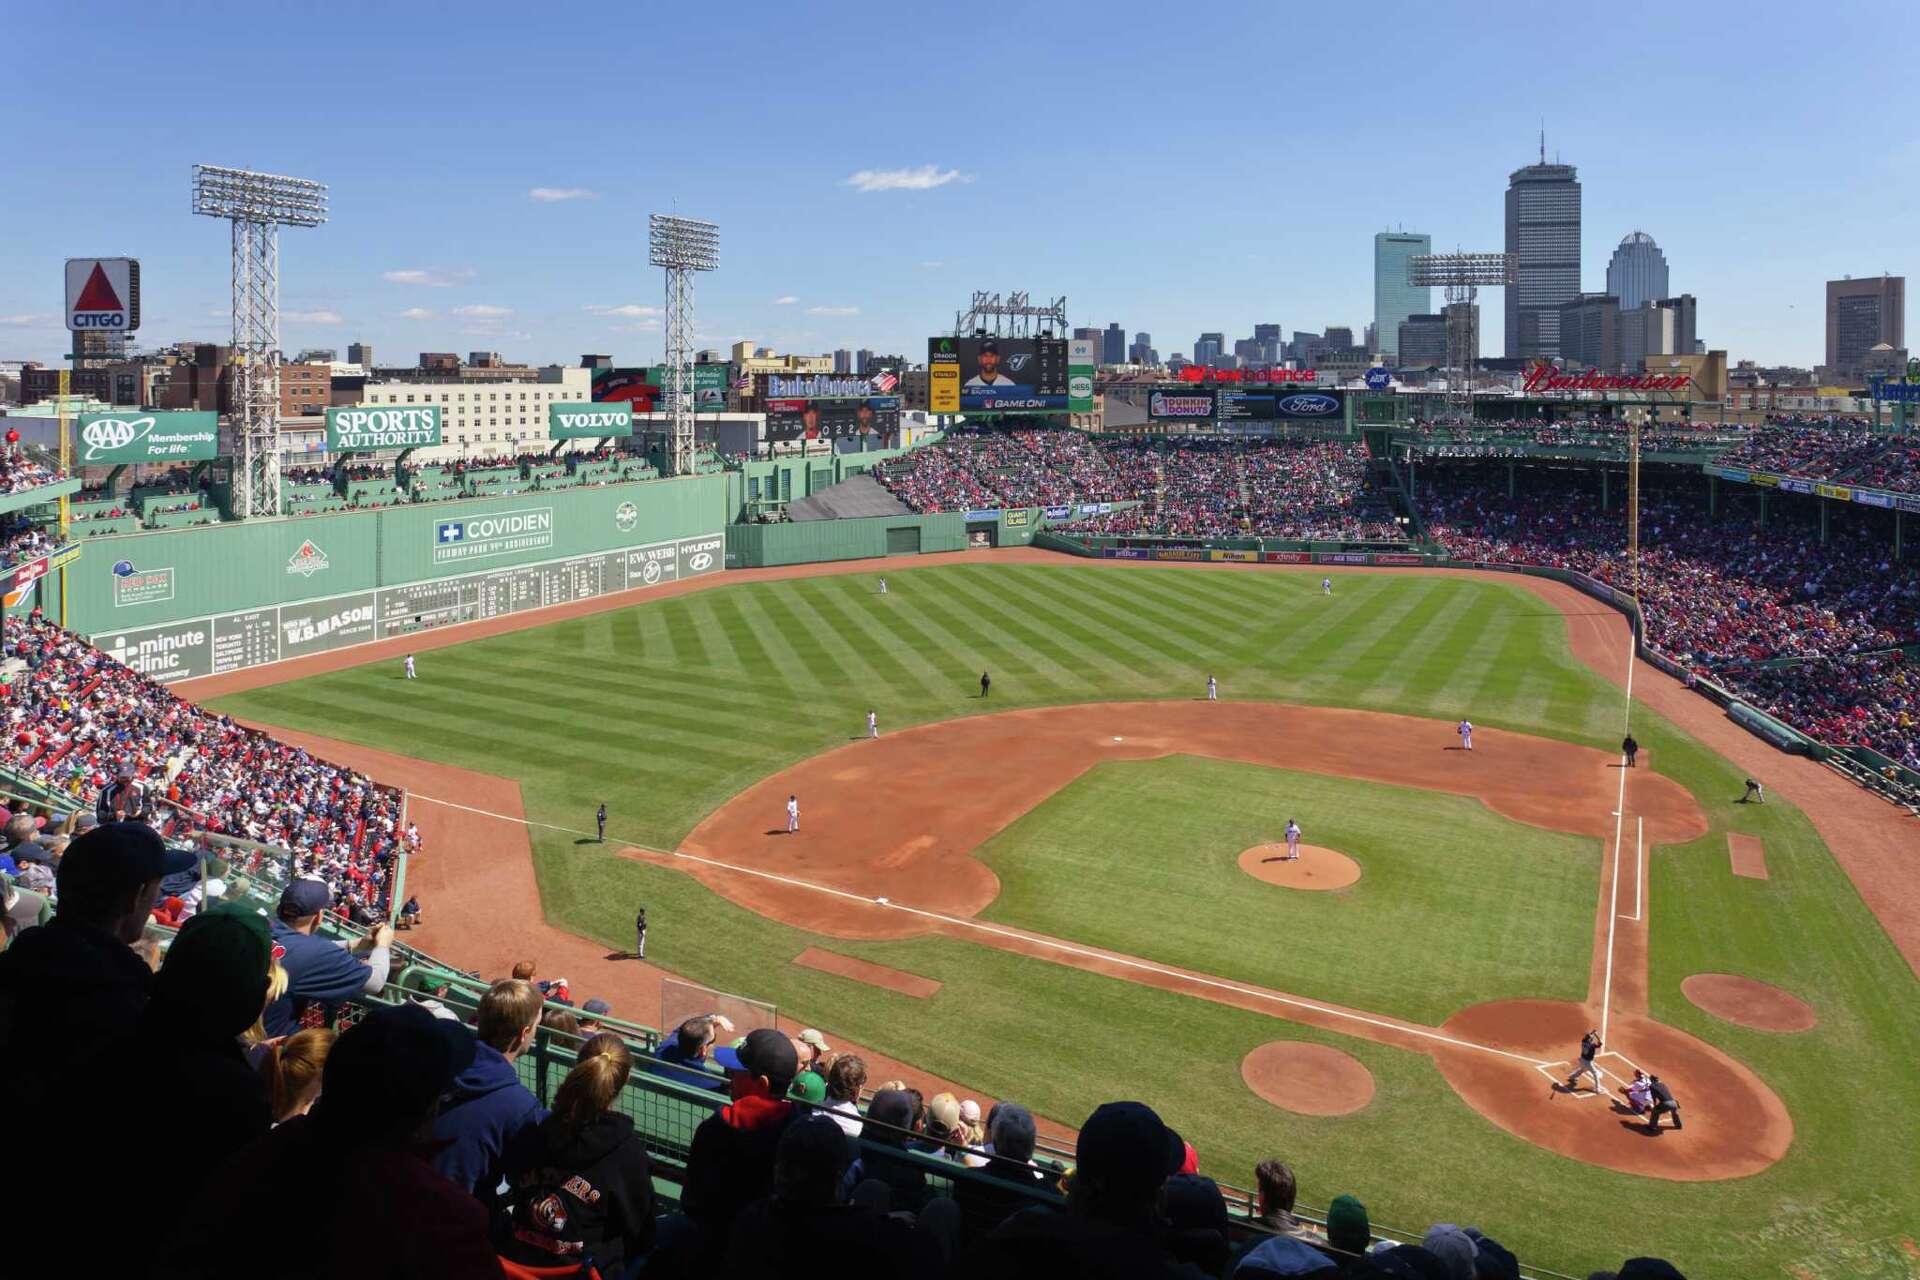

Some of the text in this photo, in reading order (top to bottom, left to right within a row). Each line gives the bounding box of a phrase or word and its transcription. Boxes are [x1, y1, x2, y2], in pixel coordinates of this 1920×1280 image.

[73, 313, 125, 328] CITGO
[767, 375, 804, 397] Bank
[1522, 364, 1690, 393] Budweiser
[1072, 383, 1091, 391] HESS
[995, 399, 1047, 408] GAME ON!
[1168, 396, 1211, 408] DUNKIN'
[1293, 397, 1327, 412] Ford
[1168, 406, 1210, 417] DONUTS
[336, 409, 434, 434] SPORTS
[557, 413, 629, 428] VOLVO
[88, 420, 131, 448] AAA
[148, 432, 215, 443] Membership
[337, 430, 434, 448] AUTHORITY
[147, 444, 188, 455] For life
[468, 512, 550, 538] COVIDIEN
[680, 541, 721, 555] HYUNDAI
[1223, 551, 1246, 559] Nikon
[288, 605, 374, 644] W.B.MASON
[140, 631, 205, 655] minute
[130, 651, 181, 673] clinic
